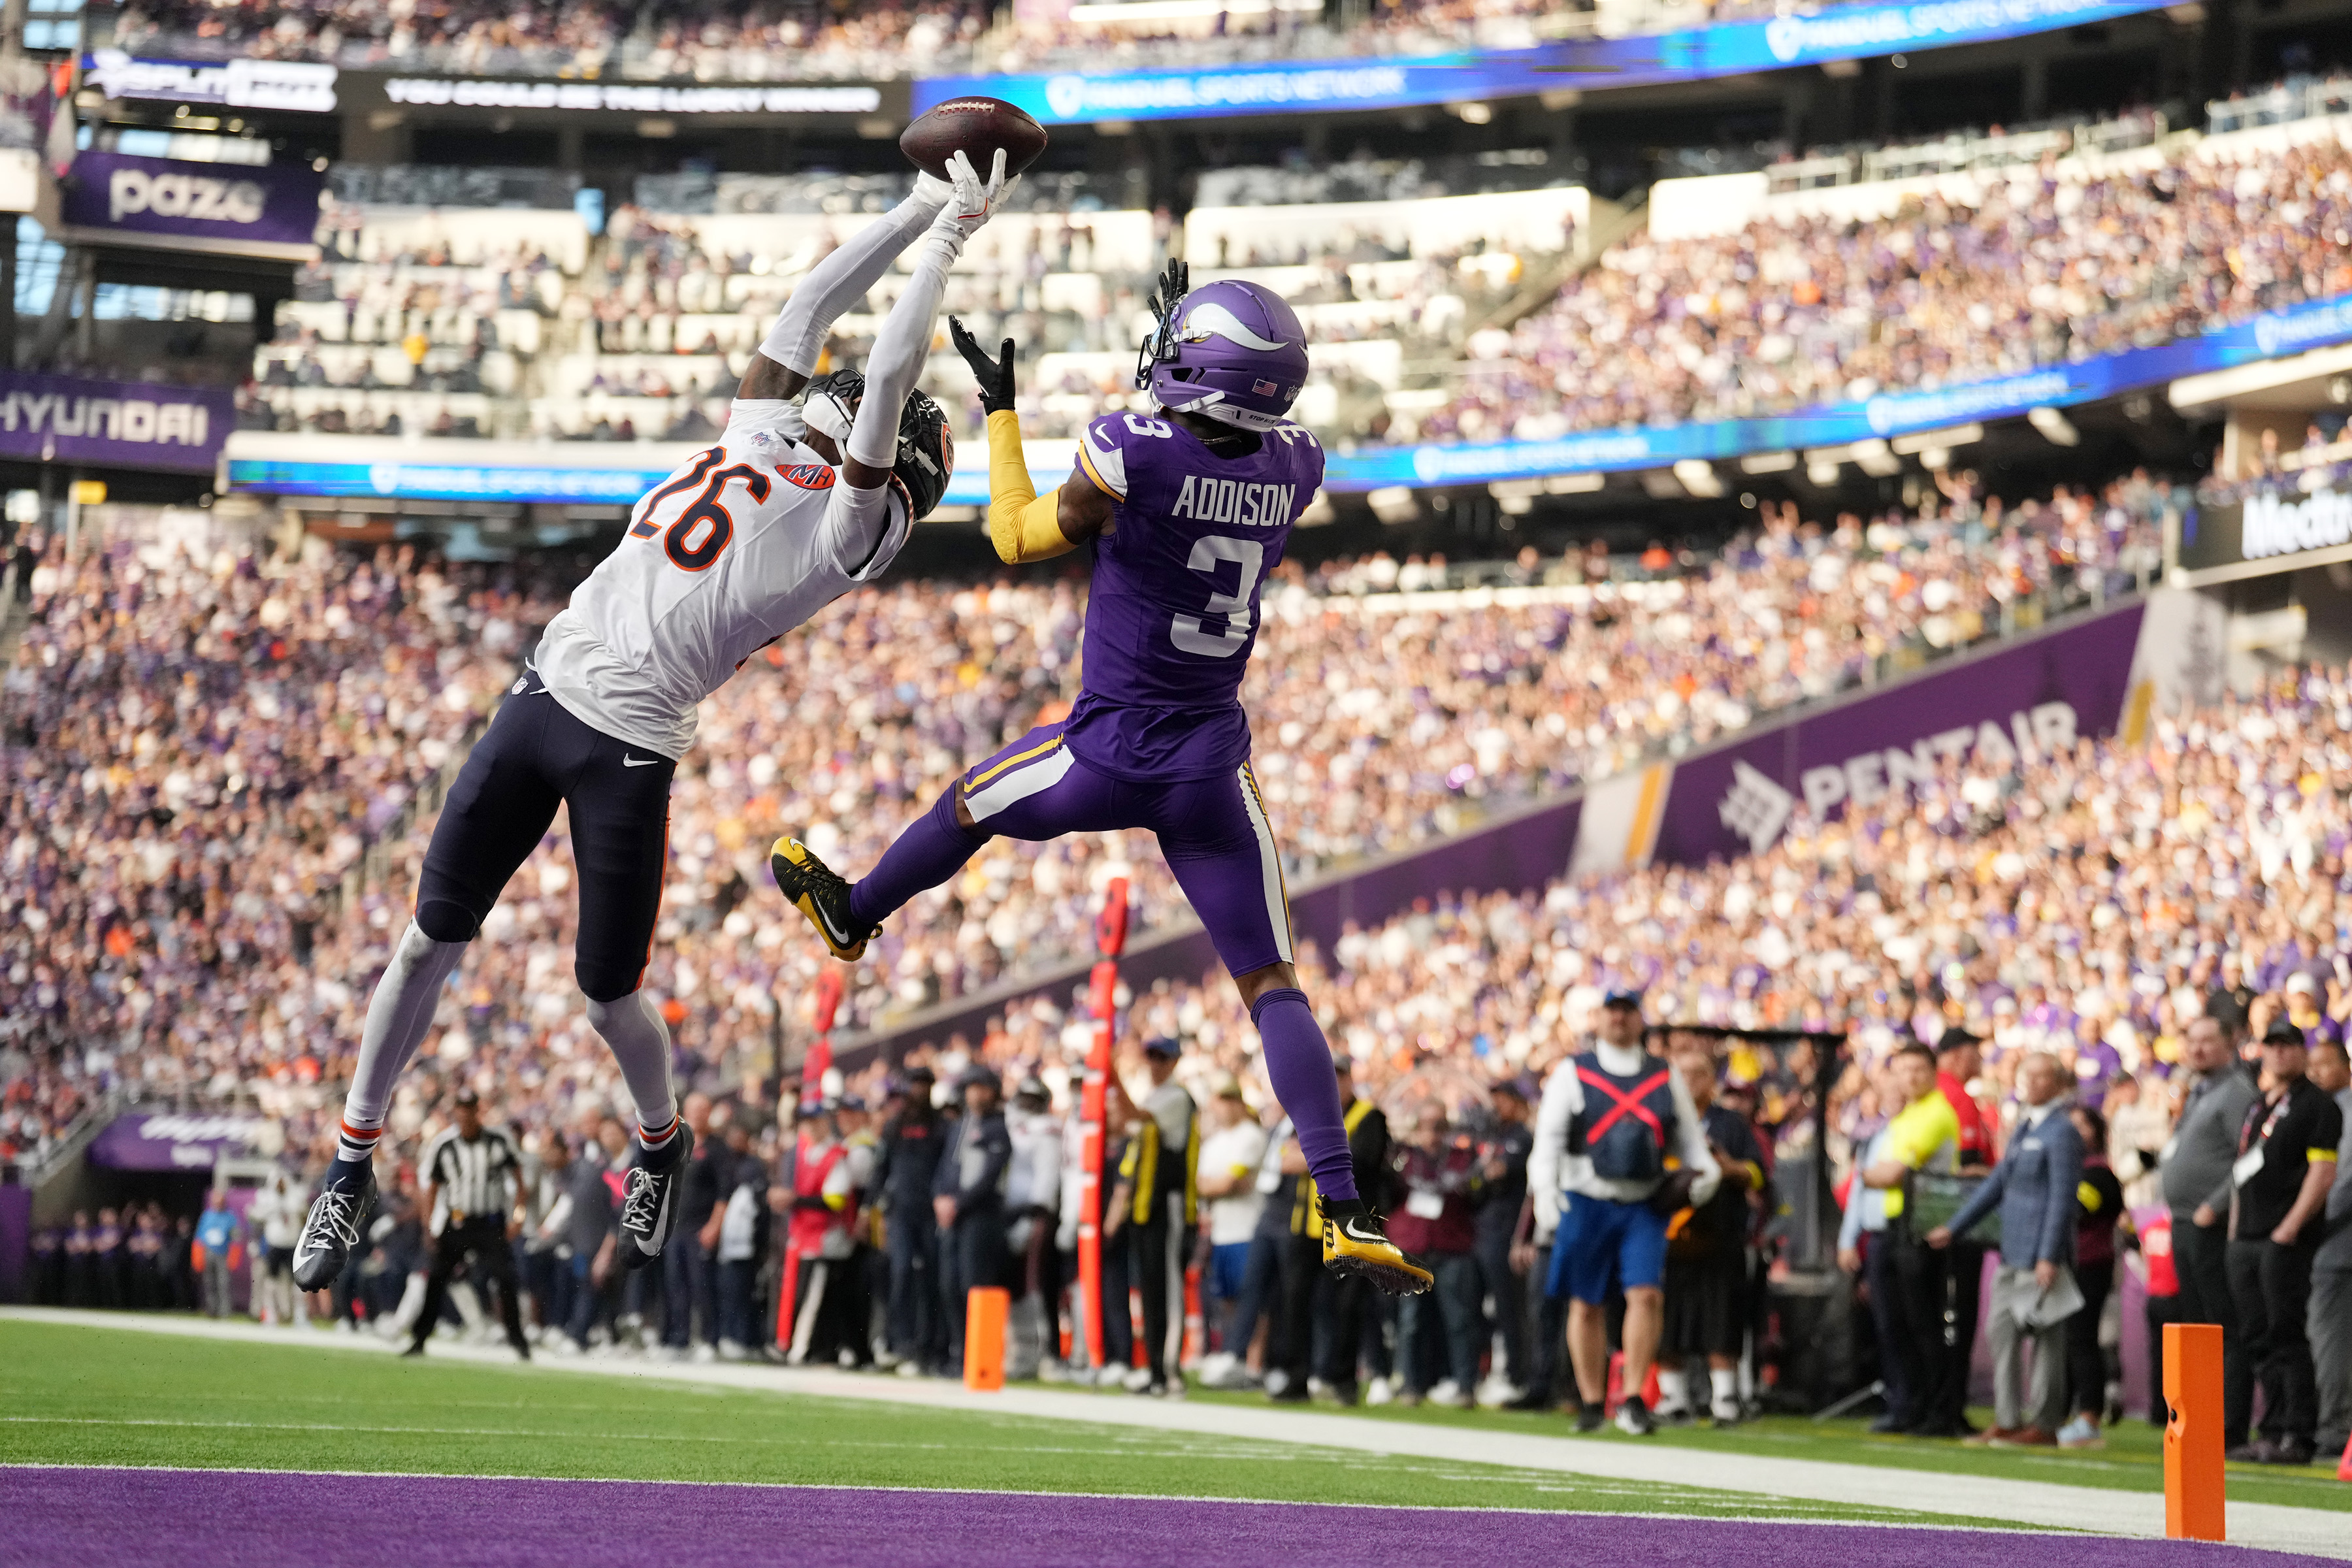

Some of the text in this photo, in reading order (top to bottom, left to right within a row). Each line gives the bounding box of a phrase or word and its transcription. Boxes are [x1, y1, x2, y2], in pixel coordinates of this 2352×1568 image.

[384, 78, 452, 105] YOU
[1122, 414, 1173, 439] 3
[629, 446, 772, 572] 26
[1171, 474, 1296, 527] ADDISON
[1169, 534, 1264, 658] 3
[1801, 701, 2078, 825] PENTAIR
